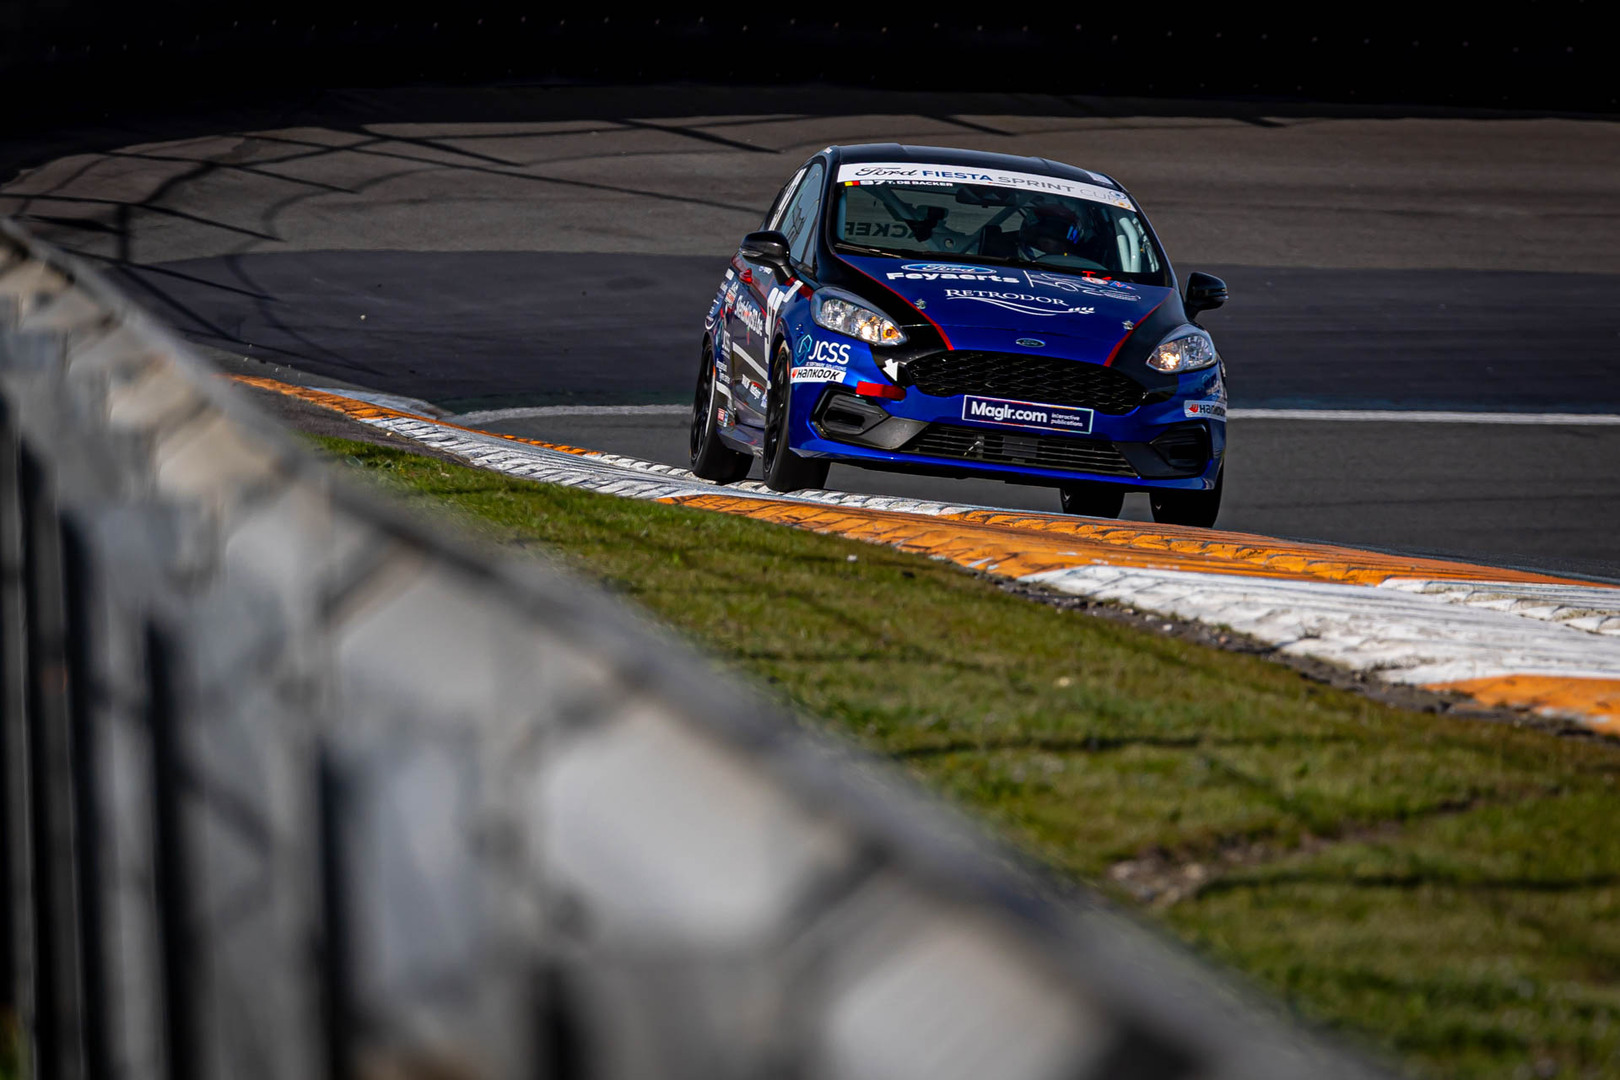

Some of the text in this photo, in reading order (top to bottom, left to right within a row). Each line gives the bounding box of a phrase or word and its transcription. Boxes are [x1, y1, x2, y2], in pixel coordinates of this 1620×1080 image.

[855, 167, 918, 177] Ford
[922, 170, 993, 182] FIESTA
[998, 176, 1075, 193] SPRINT
[886, 272, 1020, 284] Feyaerts
[944, 289, 1070, 307] RETRODOR
[808, 340, 851, 365] JCSS
[970, 401, 1048, 423] Maglr.com
[1051, 413, 1080, 421] interactive
[1050, 419, 1083, 427] publications
